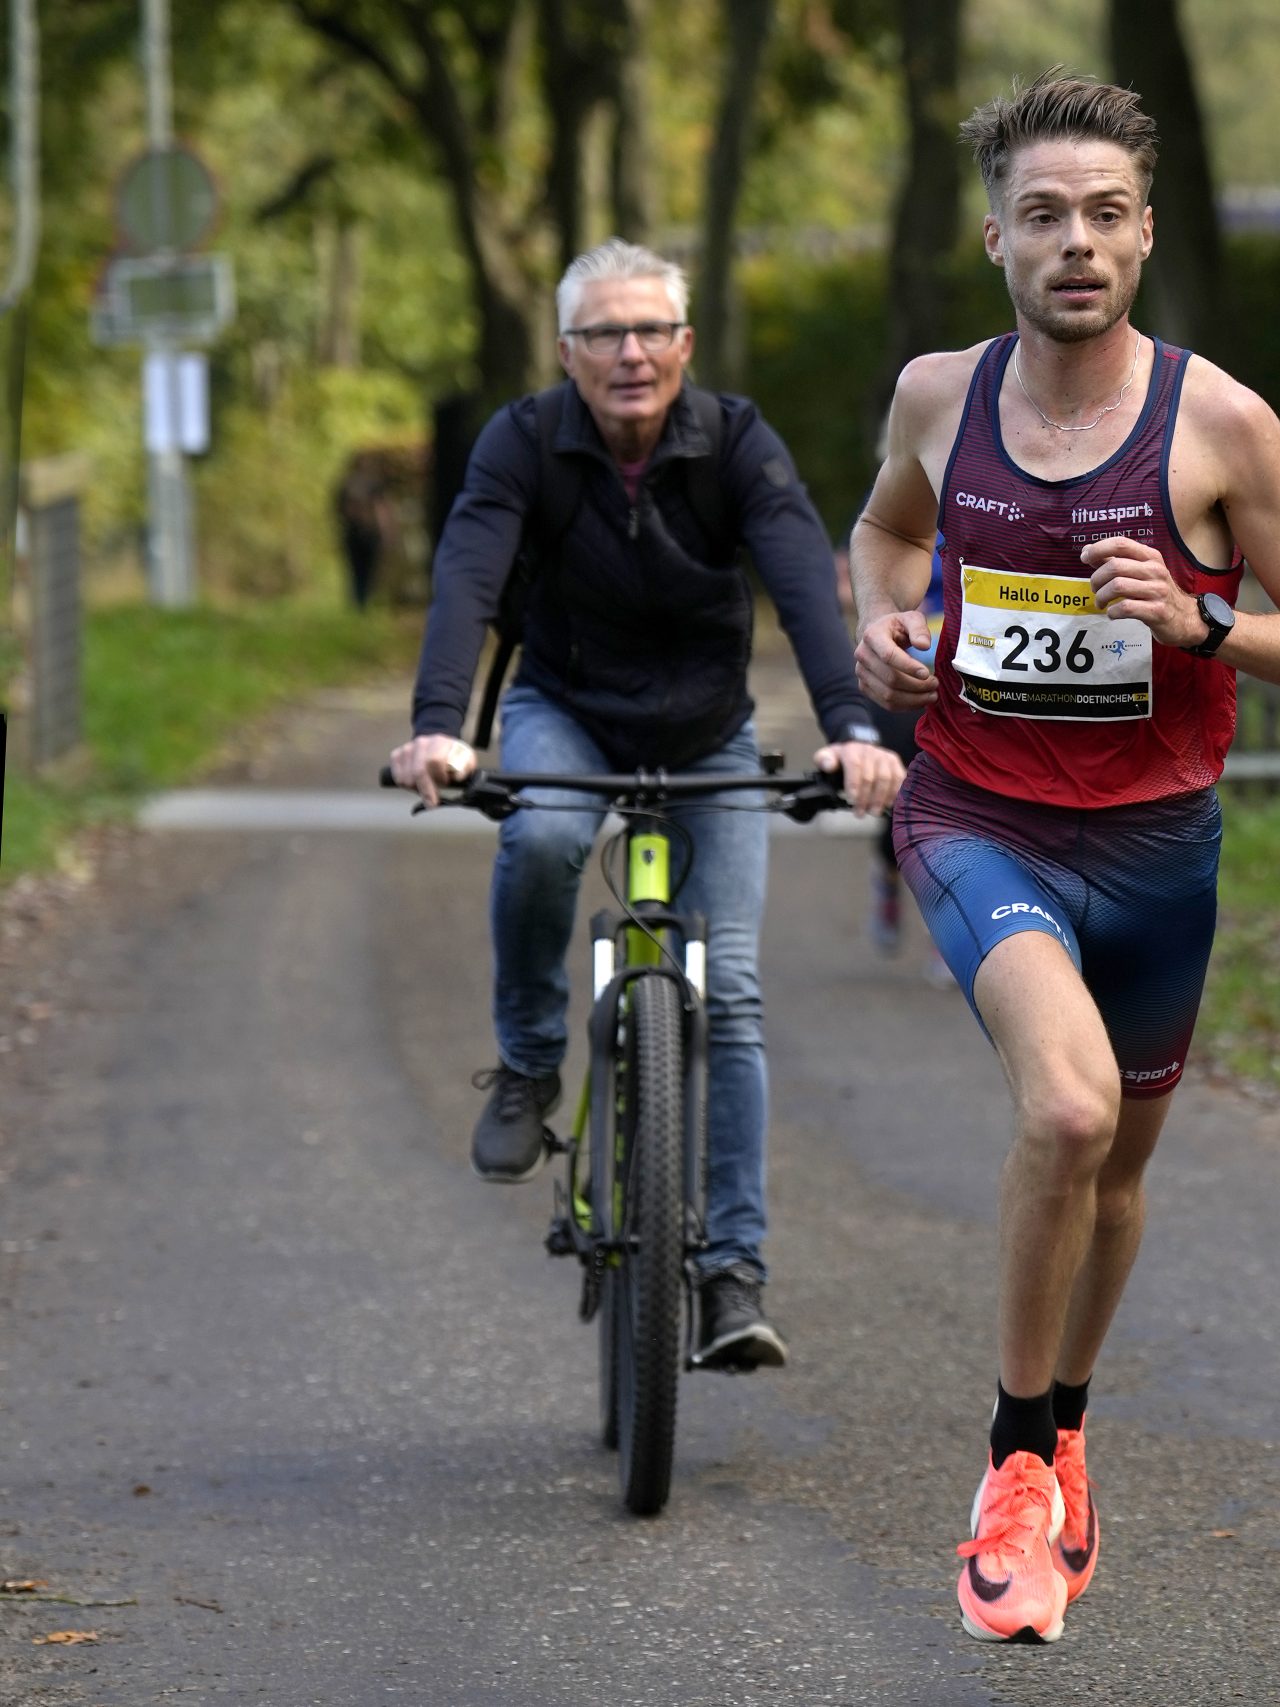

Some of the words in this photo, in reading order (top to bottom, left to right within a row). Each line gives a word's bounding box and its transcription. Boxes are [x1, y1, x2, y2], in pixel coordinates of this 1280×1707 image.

[955, 491, 1009, 516] CRAFT
[1071, 502, 1154, 524] titussport
[1071, 535, 1086, 543] TO
[1091, 529, 1133, 541] COUNT
[1137, 528, 1154, 536] ON
[999, 585, 1040, 603] Hallo
[1044, 589, 1090, 608] Loper
[1001, 625, 1095, 674] 236
